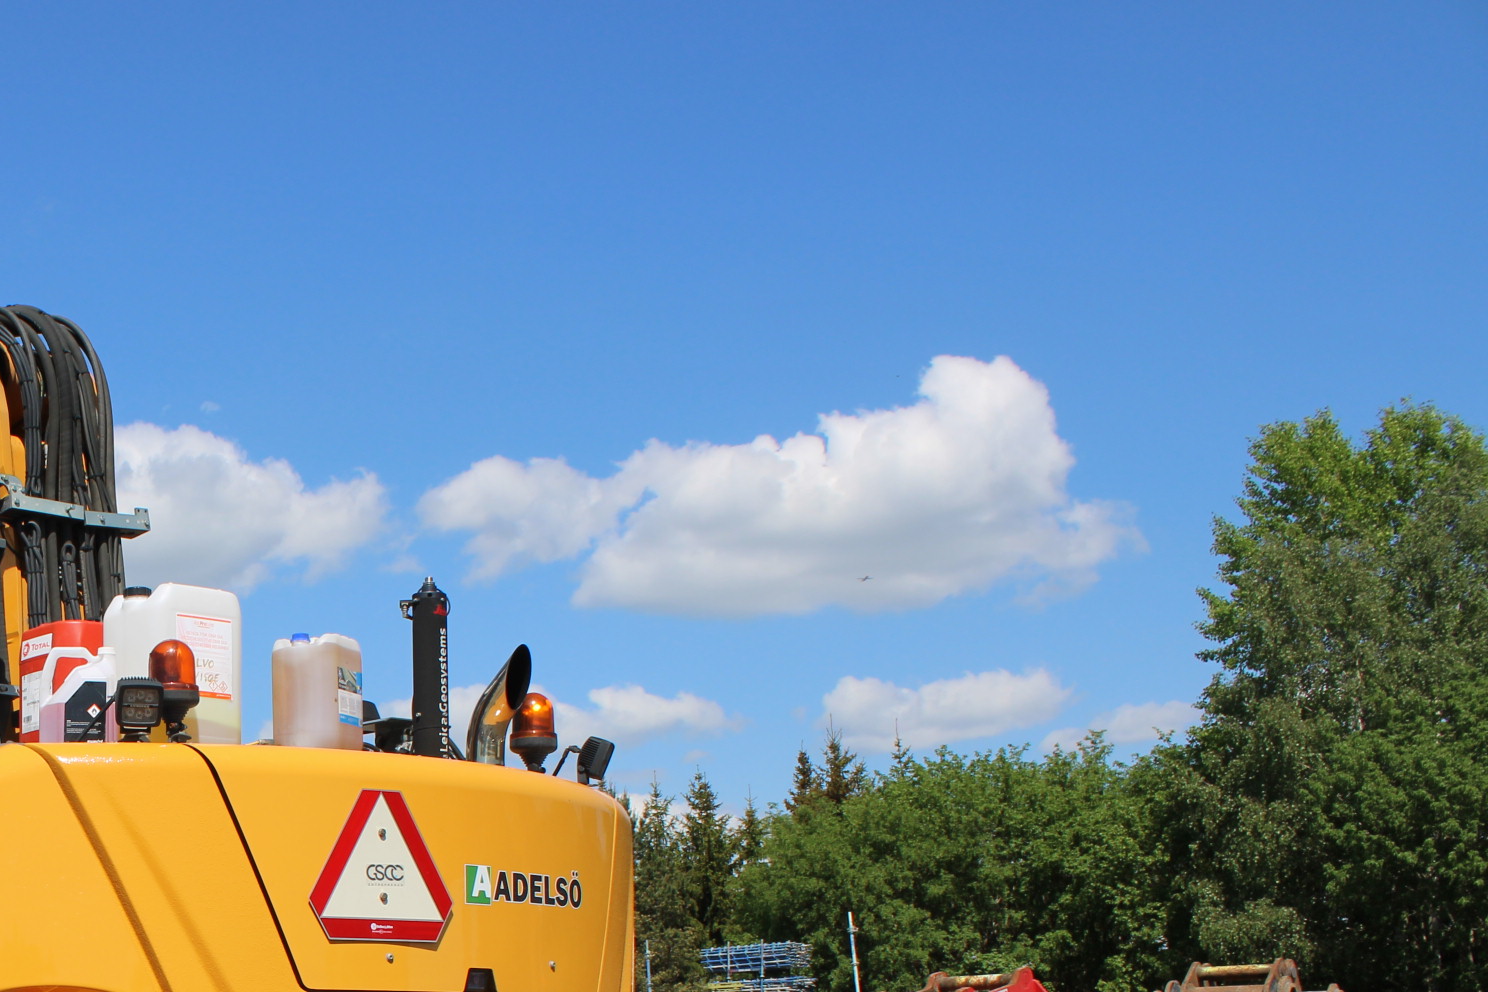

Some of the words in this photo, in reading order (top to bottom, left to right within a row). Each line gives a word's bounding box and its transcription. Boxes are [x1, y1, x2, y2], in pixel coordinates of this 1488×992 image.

[32, 642, 50, 651] TOTAL
[196, 658, 214, 669] LVO
[439, 628, 448, 712] Geosystems
[439, 717, 448, 752] Leica
[366, 864, 404, 881] GSCC
[494, 870, 582, 909] ADELSÖ
